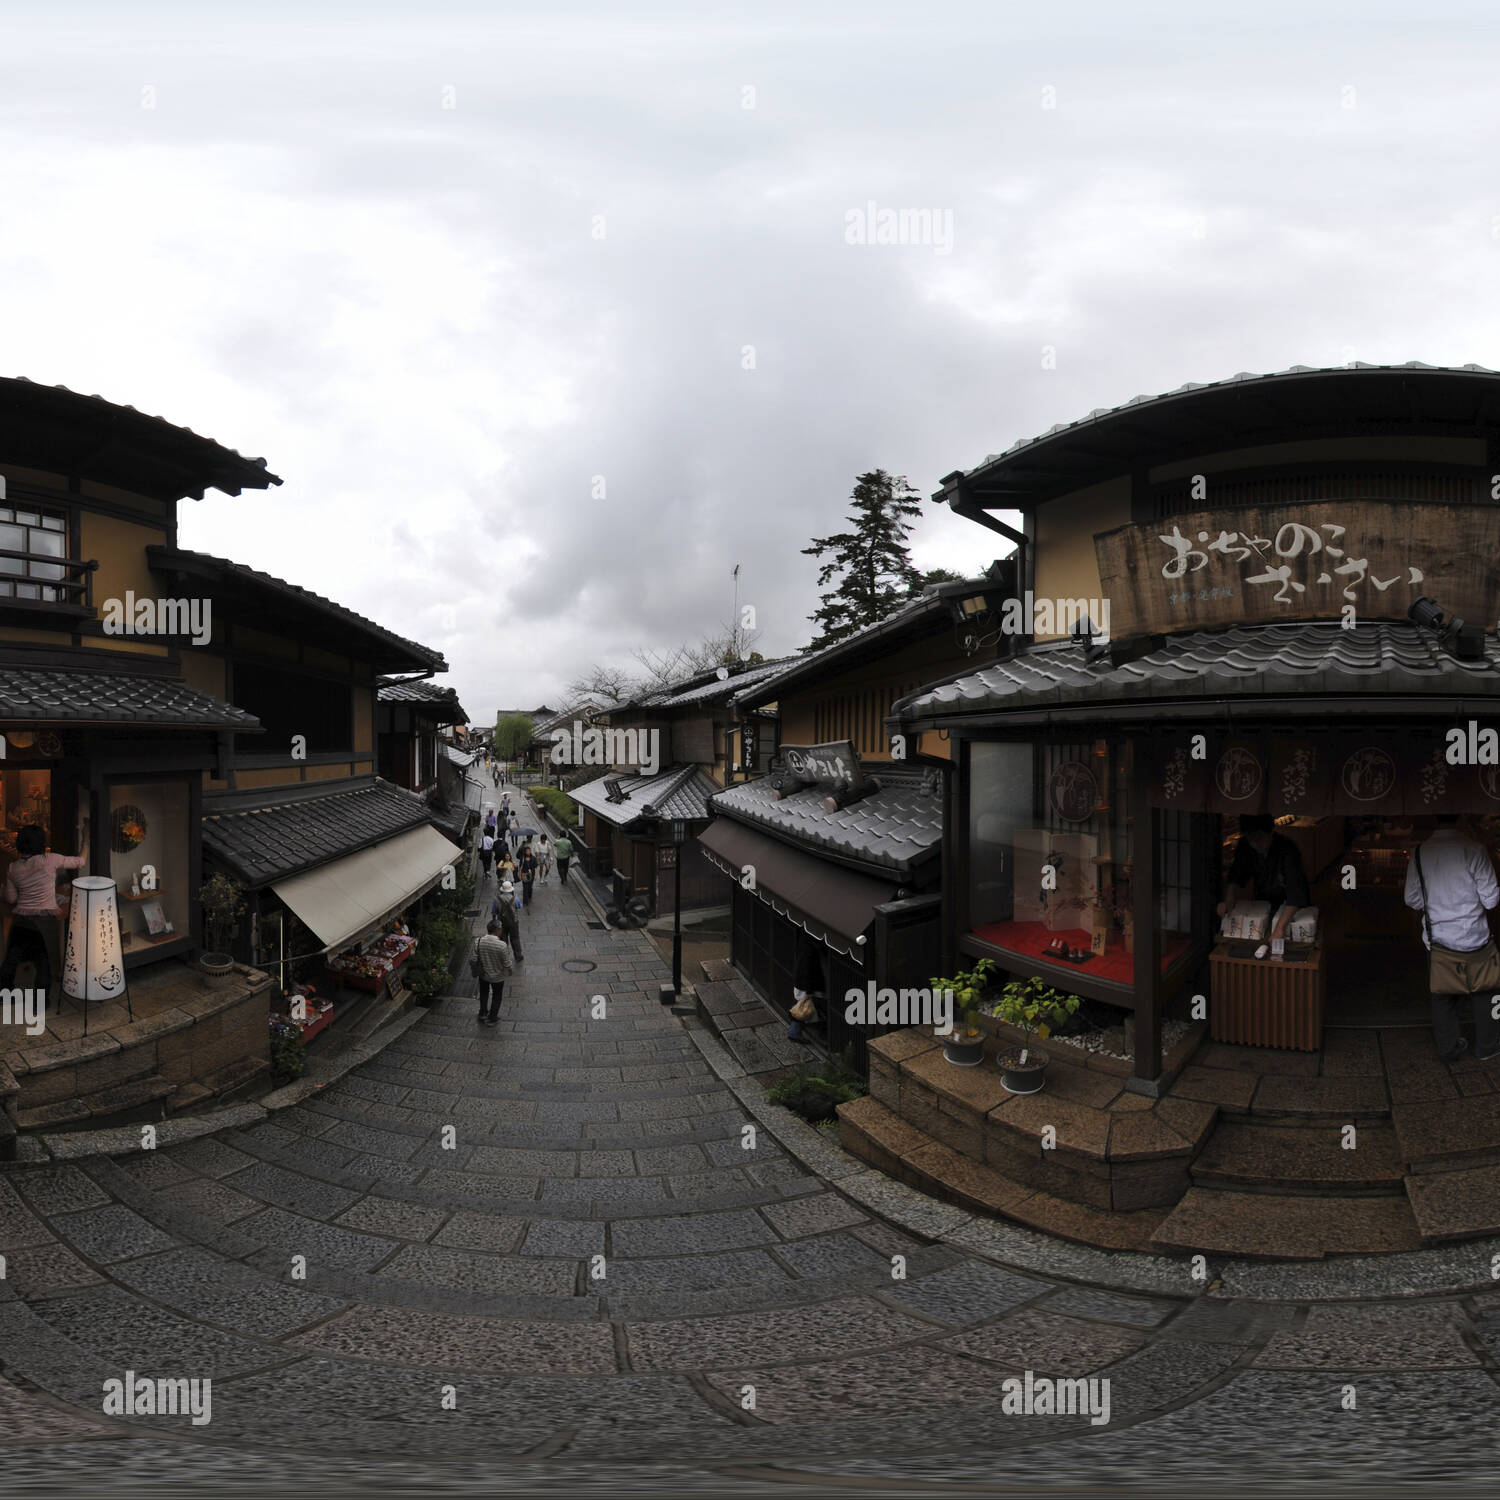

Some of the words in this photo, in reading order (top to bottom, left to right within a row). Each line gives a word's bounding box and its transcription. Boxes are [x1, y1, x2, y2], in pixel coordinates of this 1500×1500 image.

[1158, 522, 1346, 580] おちゃのこ
